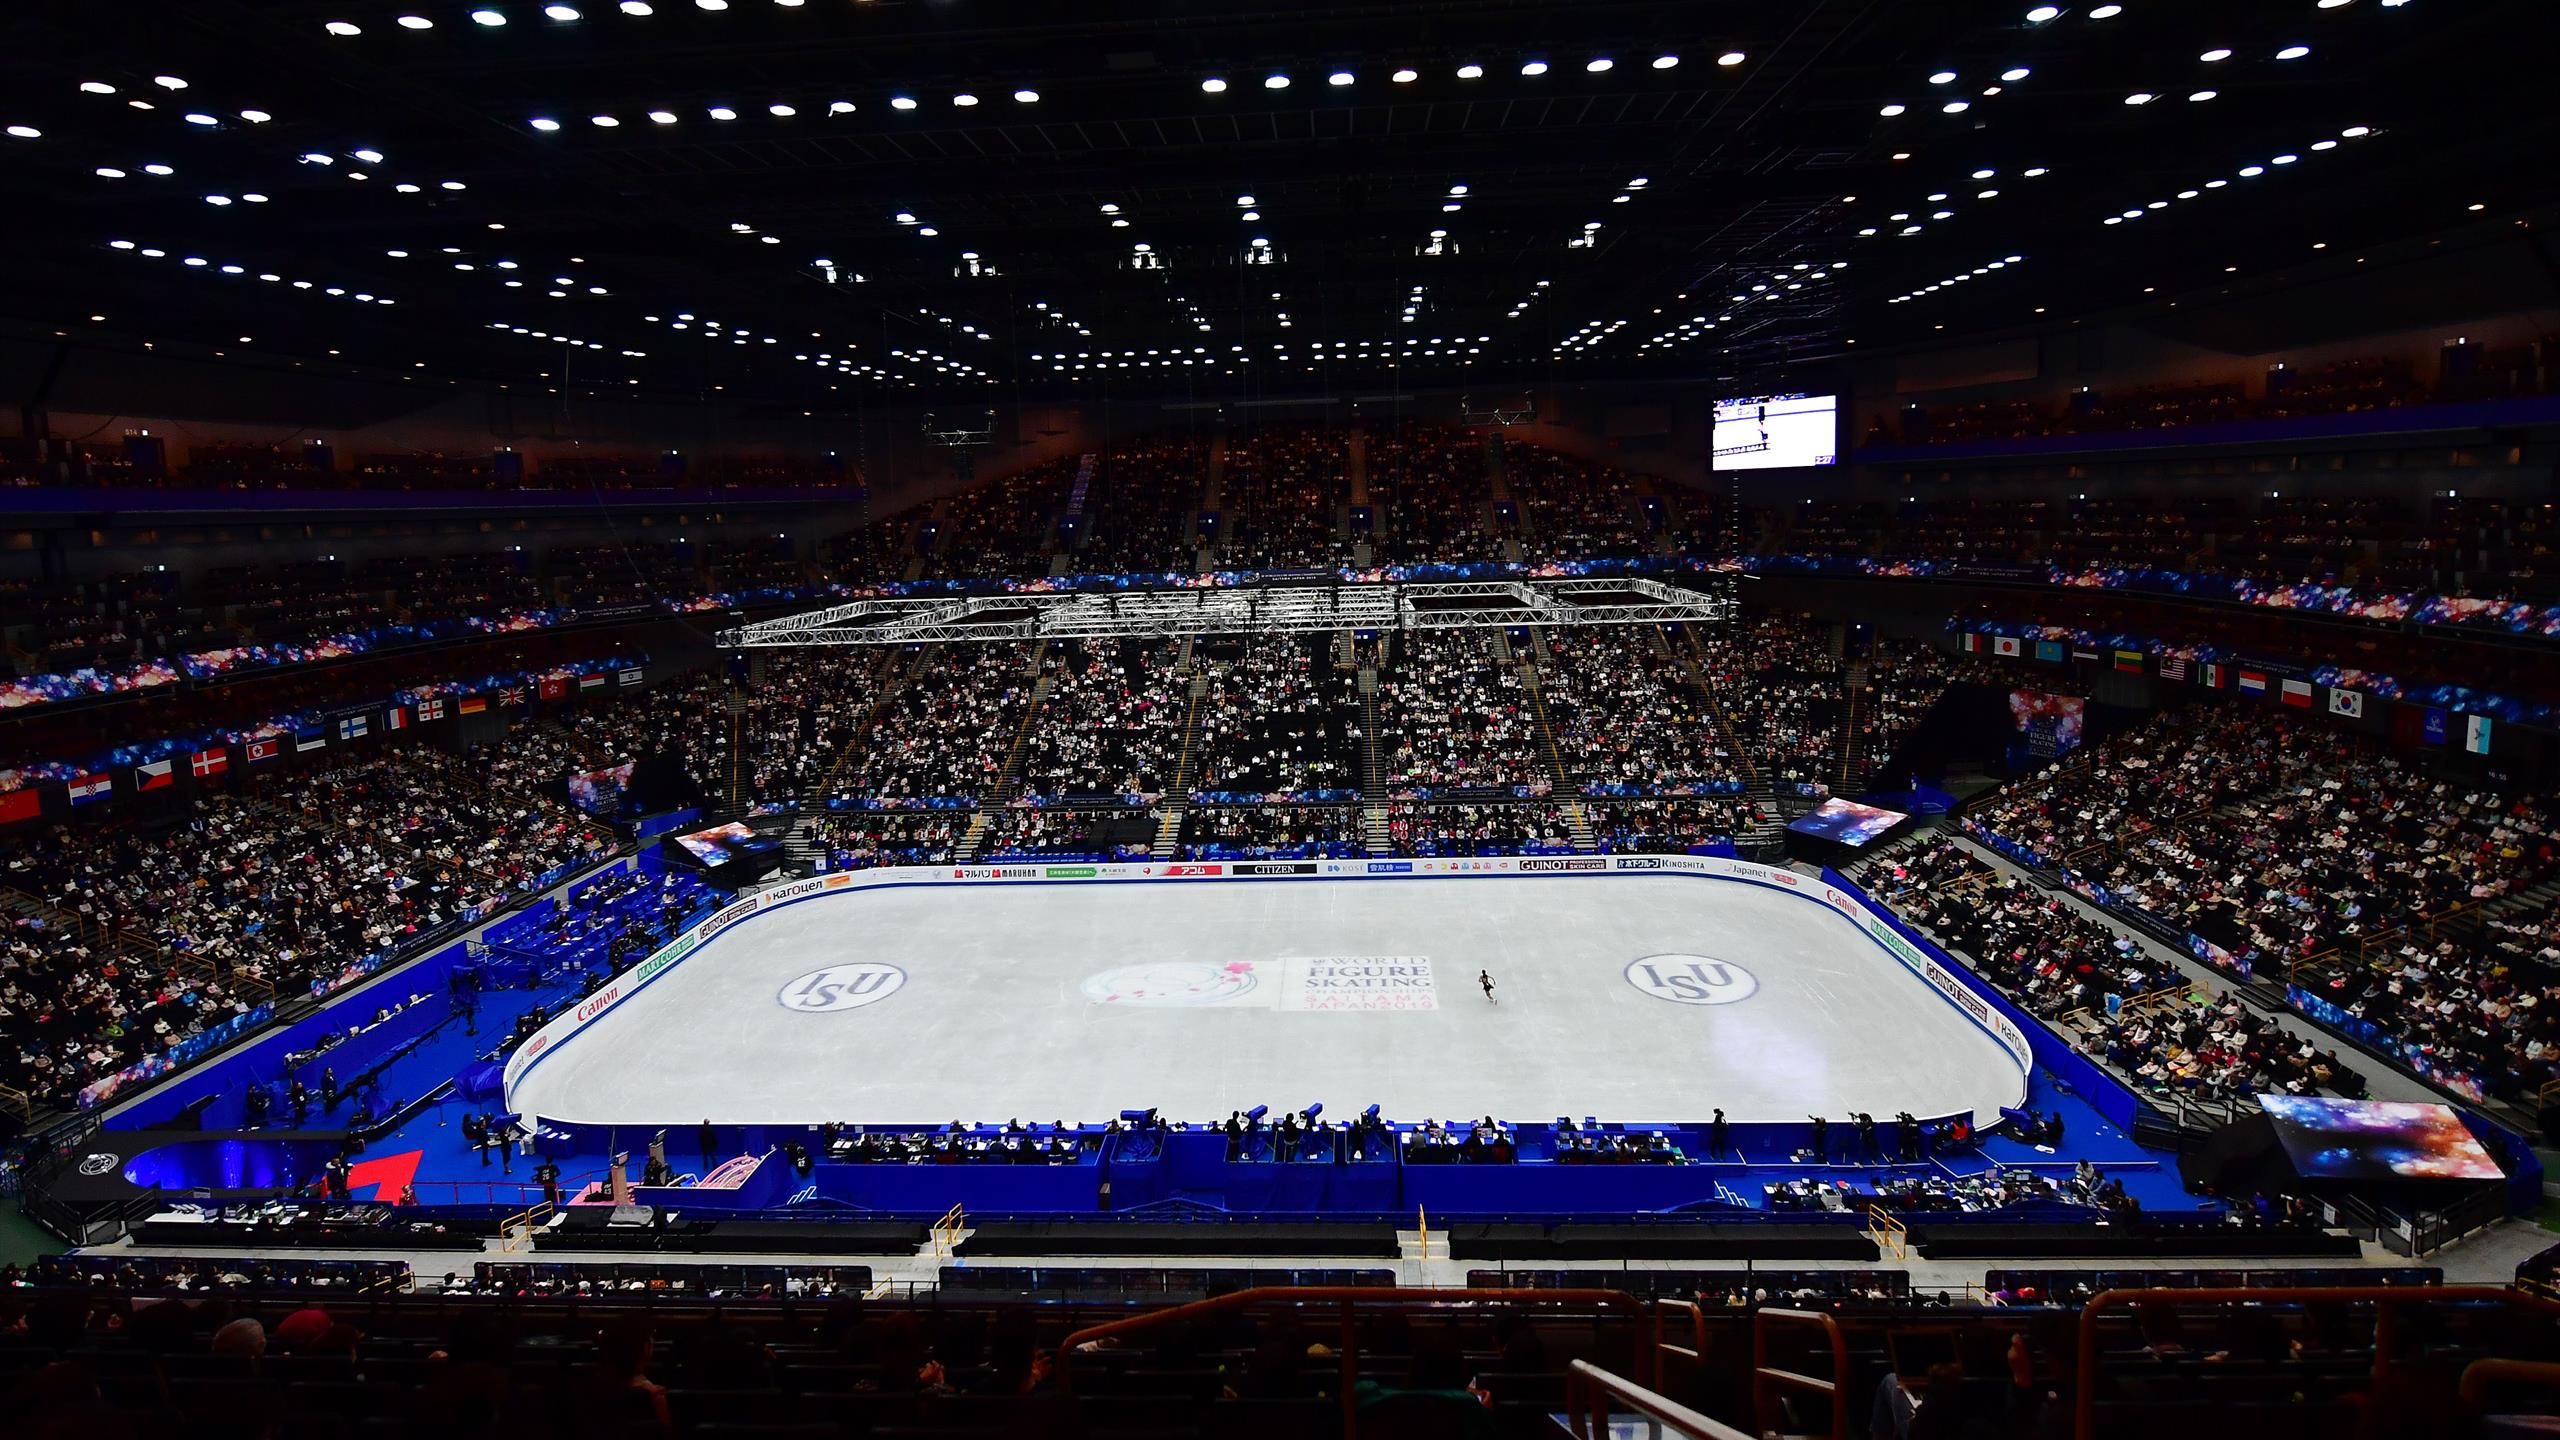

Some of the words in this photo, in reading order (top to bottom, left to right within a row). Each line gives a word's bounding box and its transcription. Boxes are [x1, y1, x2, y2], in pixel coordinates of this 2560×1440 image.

[1254, 865, 1295, 874] CITIZEN
[1520, 860, 1569, 871] GUINOT
[1662, 859, 1705, 869] KINOSHITA
[964, 869, 991, 878] マルハン
[1002, 869, 1037, 878] MARUHAN
[1181, 866, 1206, 875] アコム
[1732, 864, 1767, 878] Japanet
[1826, 889, 1858, 918] Canon
[700, 913, 730, 938] GUINOT
[639, 954, 662, 978] MARY
[1331, 957, 1427, 965] WORLD
[1310, 966, 1430, 977] FIGURE
[1305, 978, 1432, 988] SKATING
[1639, 963, 1733, 999] ISU
[1927, 964, 1959, 999] GUINOT
[795, 972, 896, 1007] ISU
[577, 986, 618, 1022] Canon
